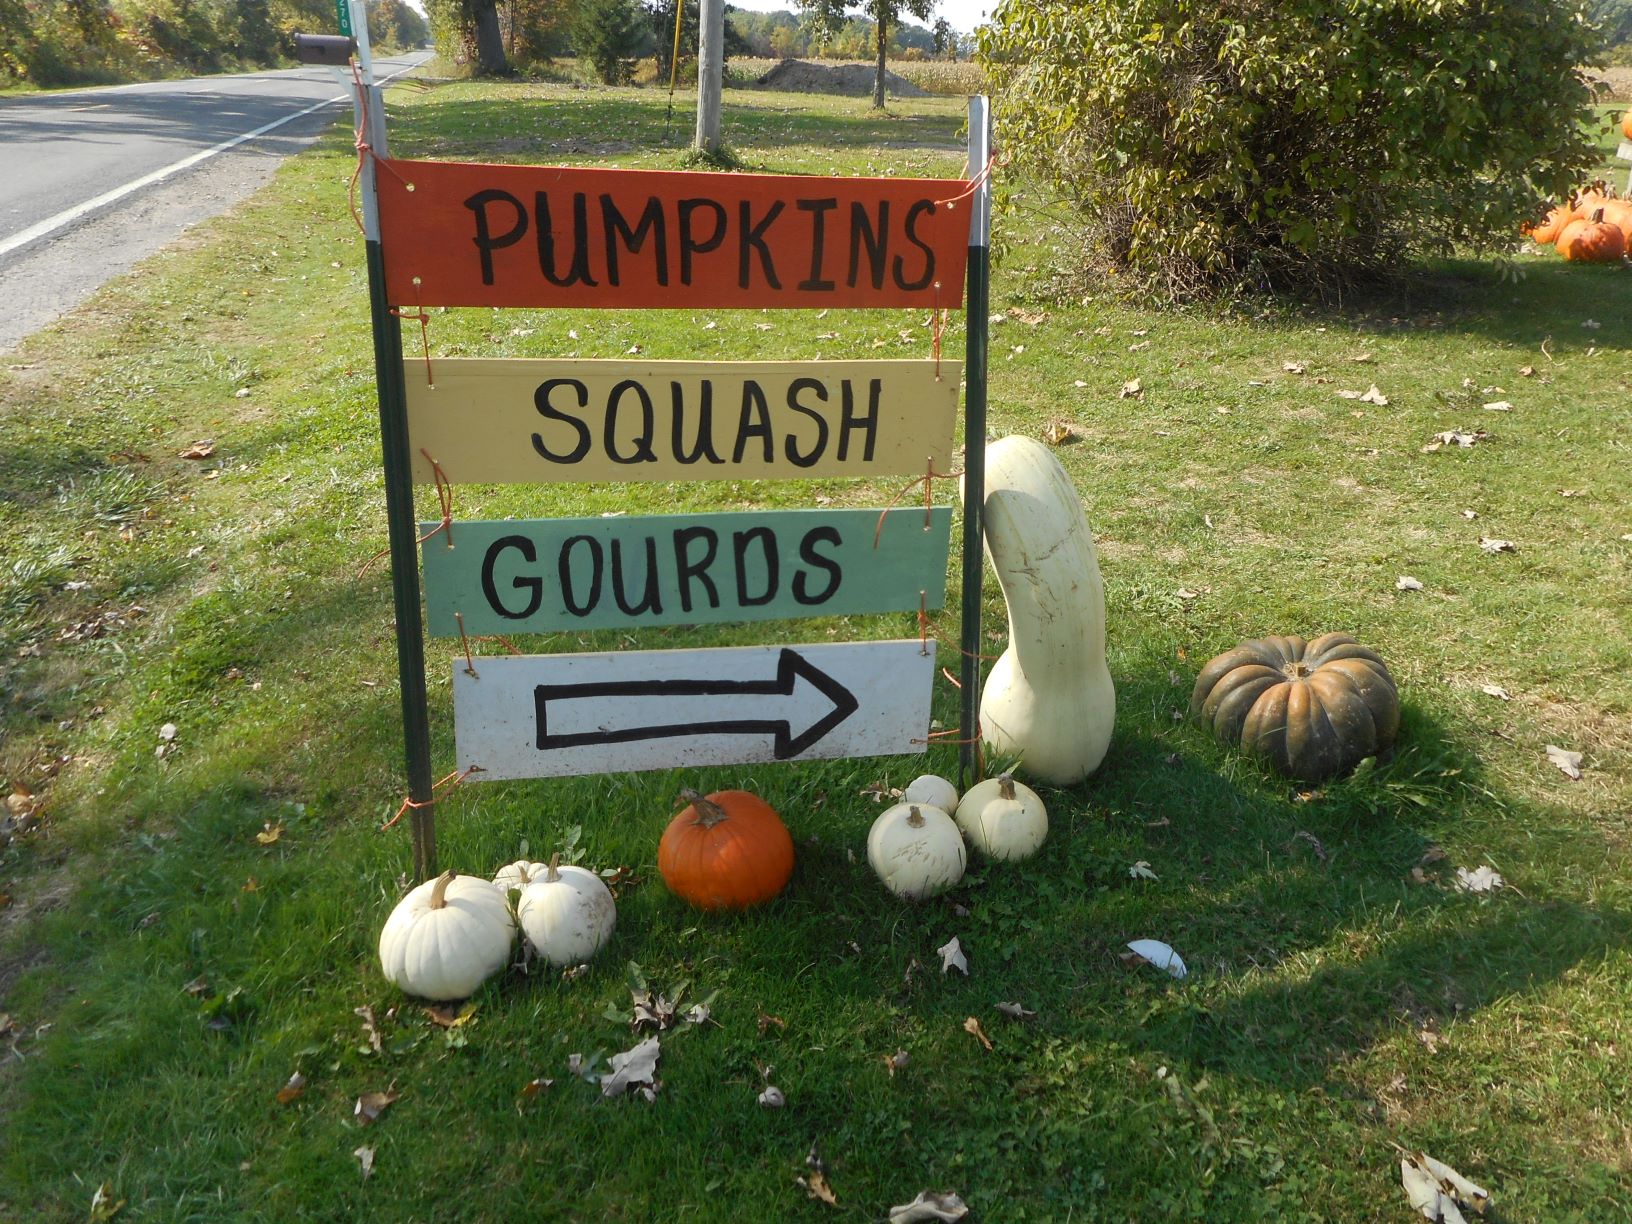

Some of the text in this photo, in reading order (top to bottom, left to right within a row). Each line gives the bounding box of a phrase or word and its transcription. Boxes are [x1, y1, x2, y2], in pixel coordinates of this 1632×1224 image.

[463, 188, 936, 292] PUMPKINS
[531, 379, 881, 468] SQUASH
[481, 526, 842, 619] GOURDS
